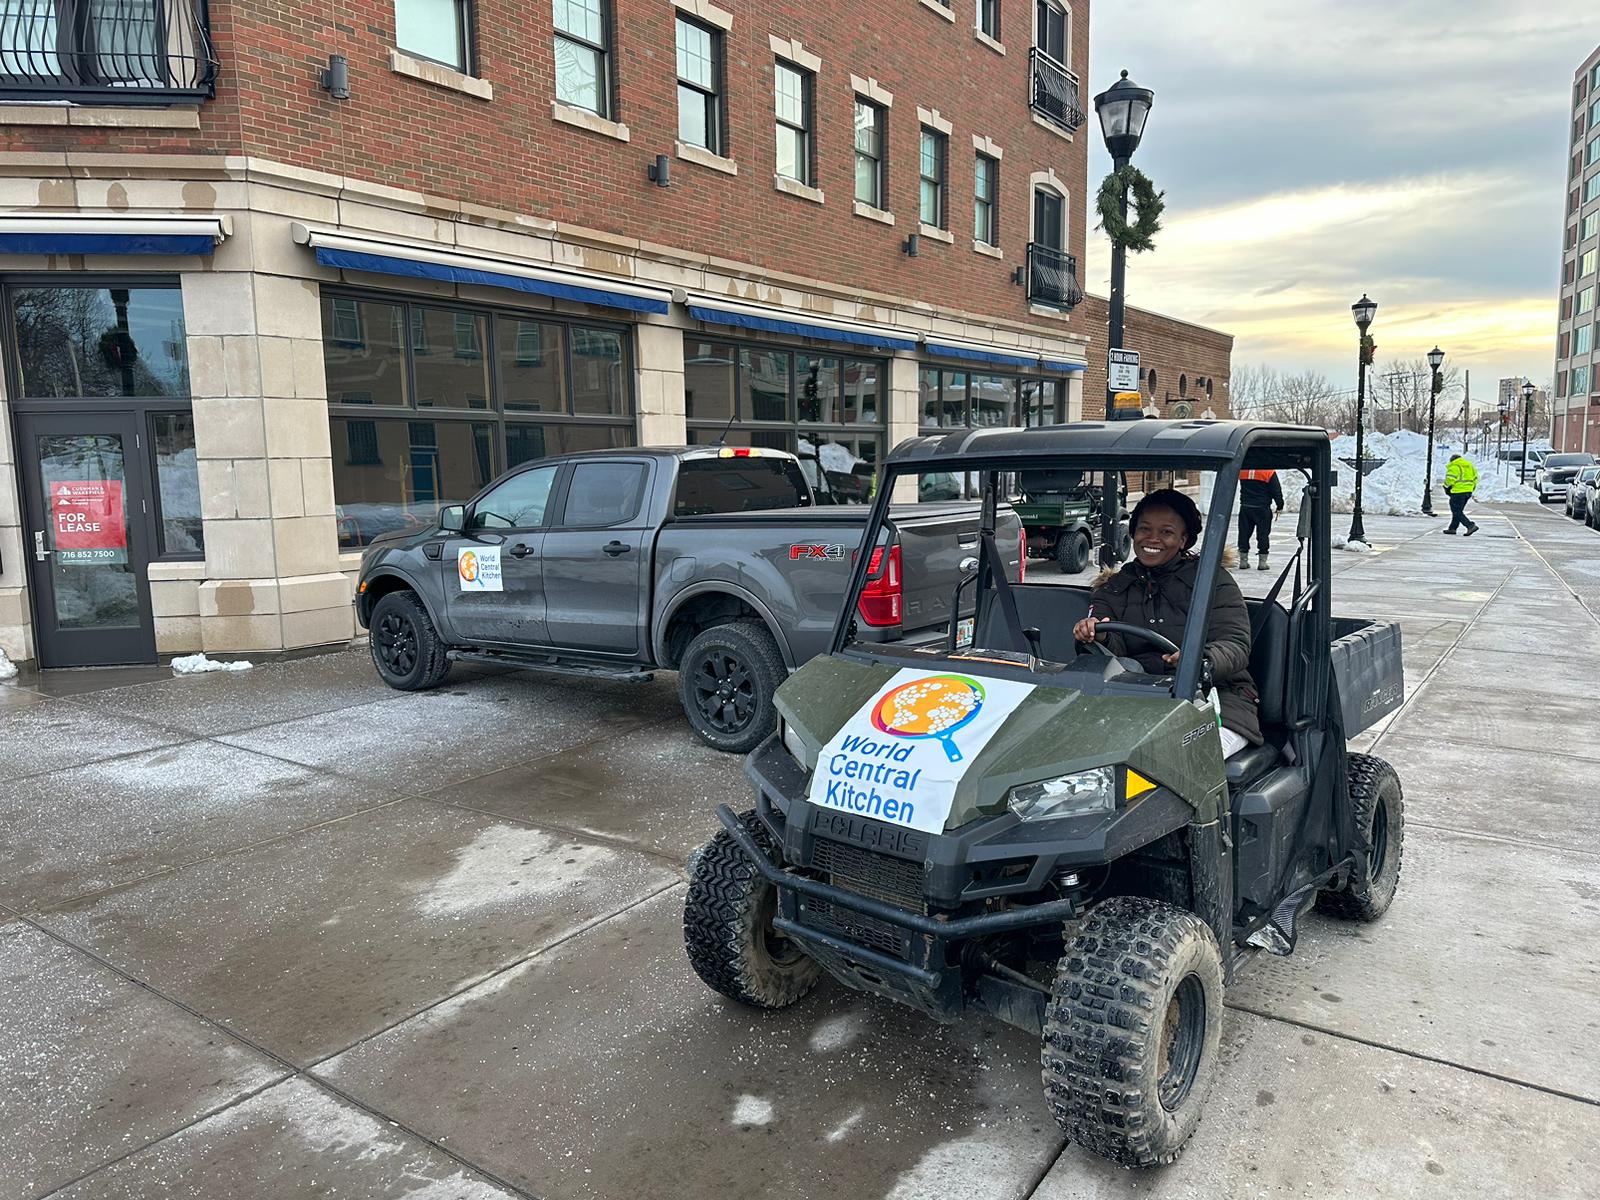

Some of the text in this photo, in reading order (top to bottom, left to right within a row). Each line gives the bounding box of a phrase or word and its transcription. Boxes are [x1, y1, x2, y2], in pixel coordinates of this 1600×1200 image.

[1114, 352, 1123, 362] HOUR
[1123, 353, 1138, 364] PARKING
[58, 513, 86, 522] FOR
[59, 523, 100, 533] LEASE
[62, 551, 76, 559] 716
[93, 550, 115, 558] 7500
[789, 543, 845, 560] FX4
[480, 554, 495, 562] World
[481, 563, 499, 571] Central
[840, 734, 915, 763] World
[829, 753, 922, 791] Central
[825, 779, 914, 824] Kitchen
[814, 810, 923, 854] POLARIS
